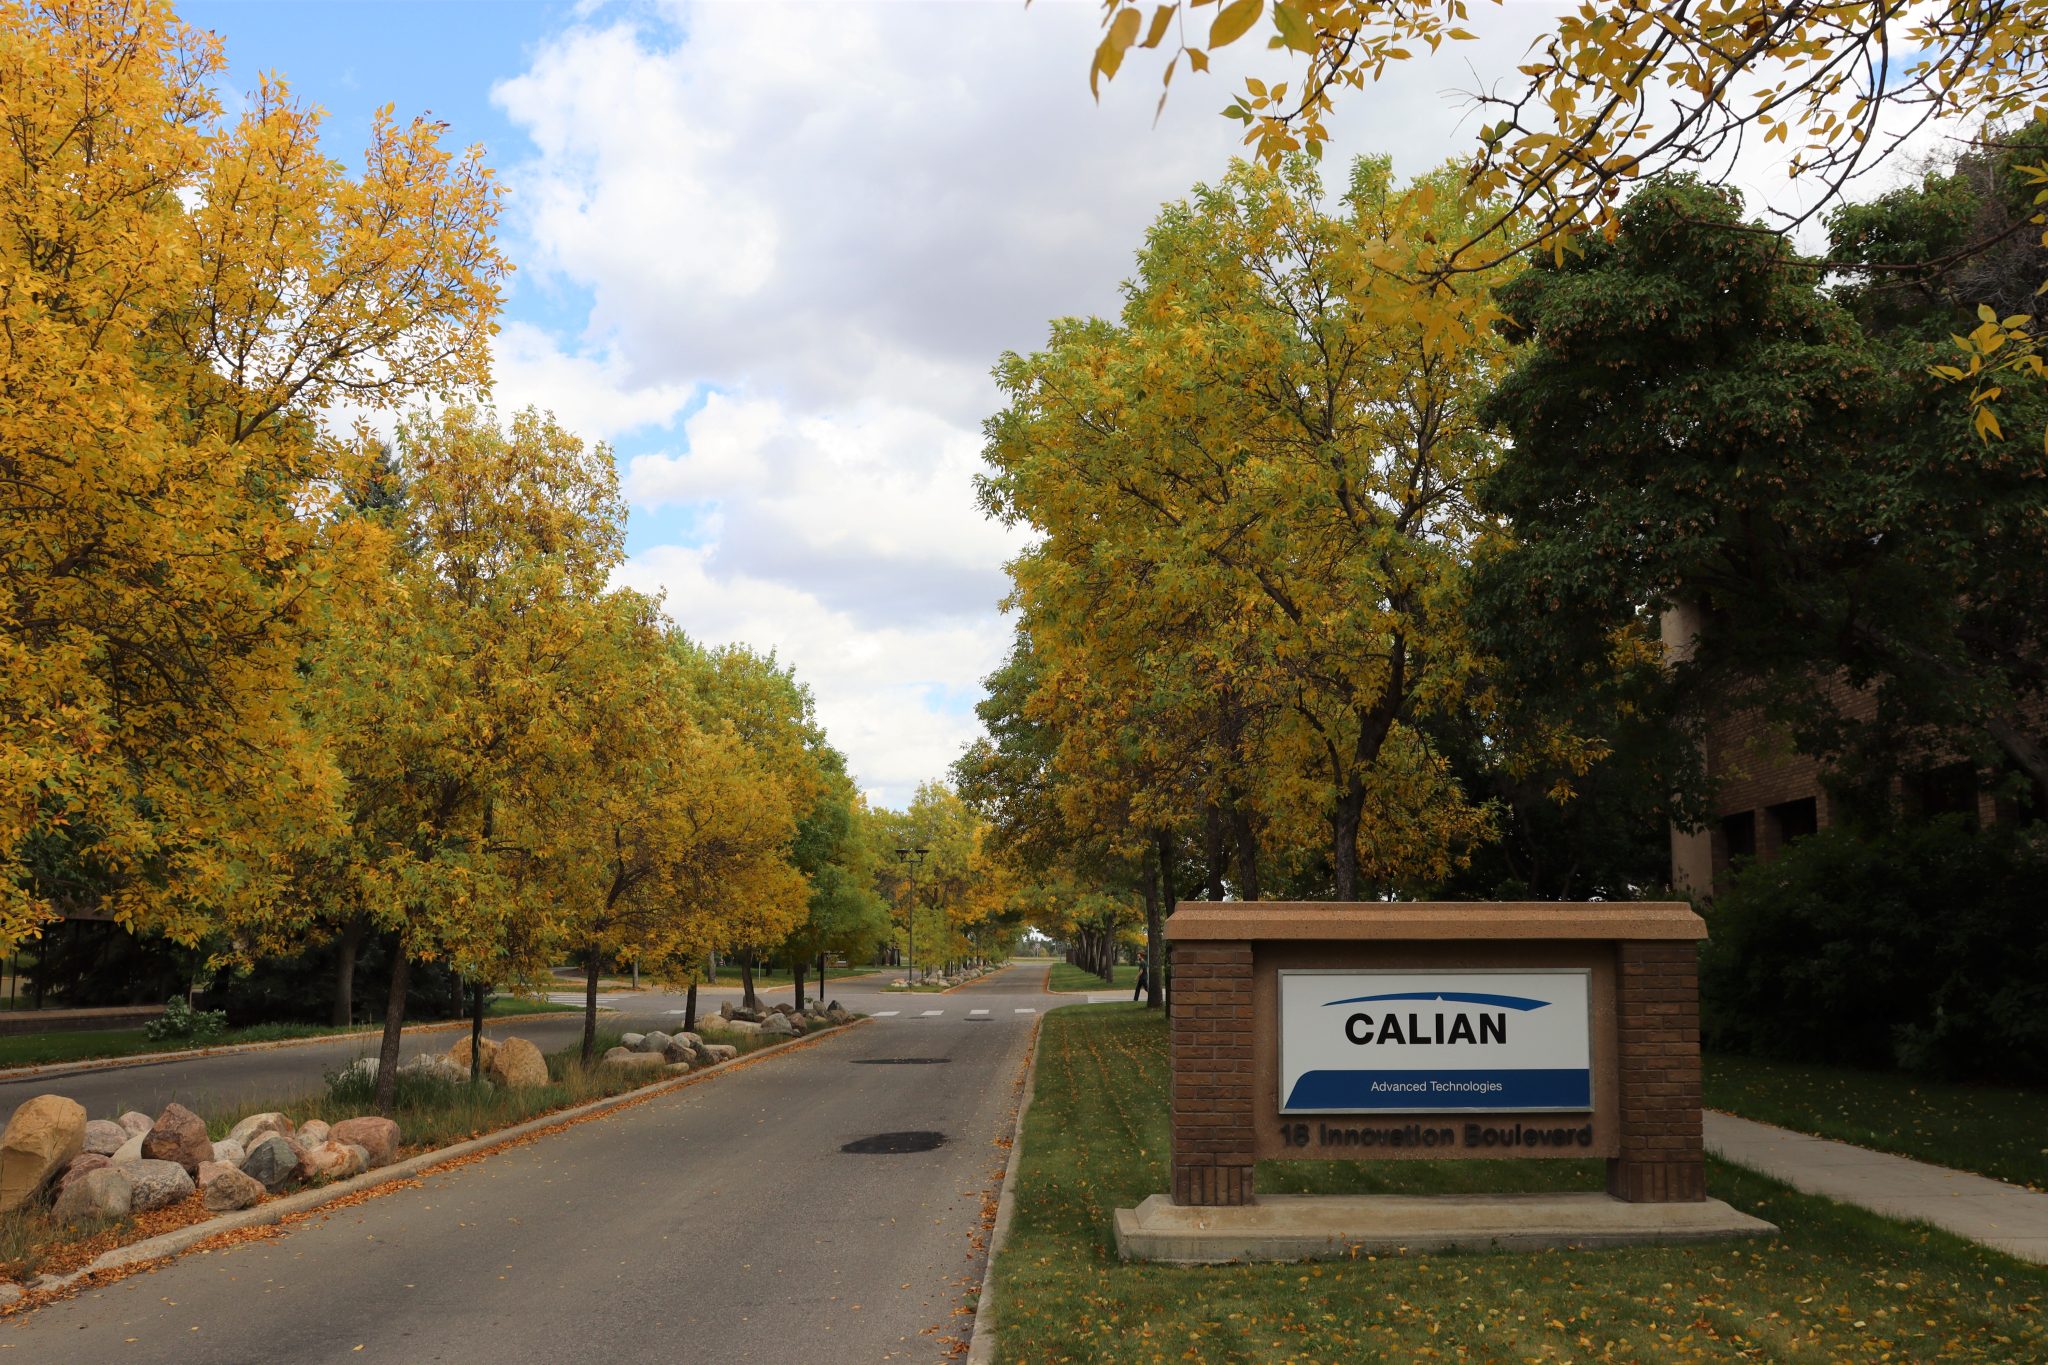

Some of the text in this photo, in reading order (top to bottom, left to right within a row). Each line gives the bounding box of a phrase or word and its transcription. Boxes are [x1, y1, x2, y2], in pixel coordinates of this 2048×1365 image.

[1344, 1012, 1507, 1045] CALIAN
[1370, 1080, 1503, 1094] Advanced Technologies
[1320, 1121, 1454, 1147] Innovation
[1464, 1122, 1593, 1147] Boulevard
